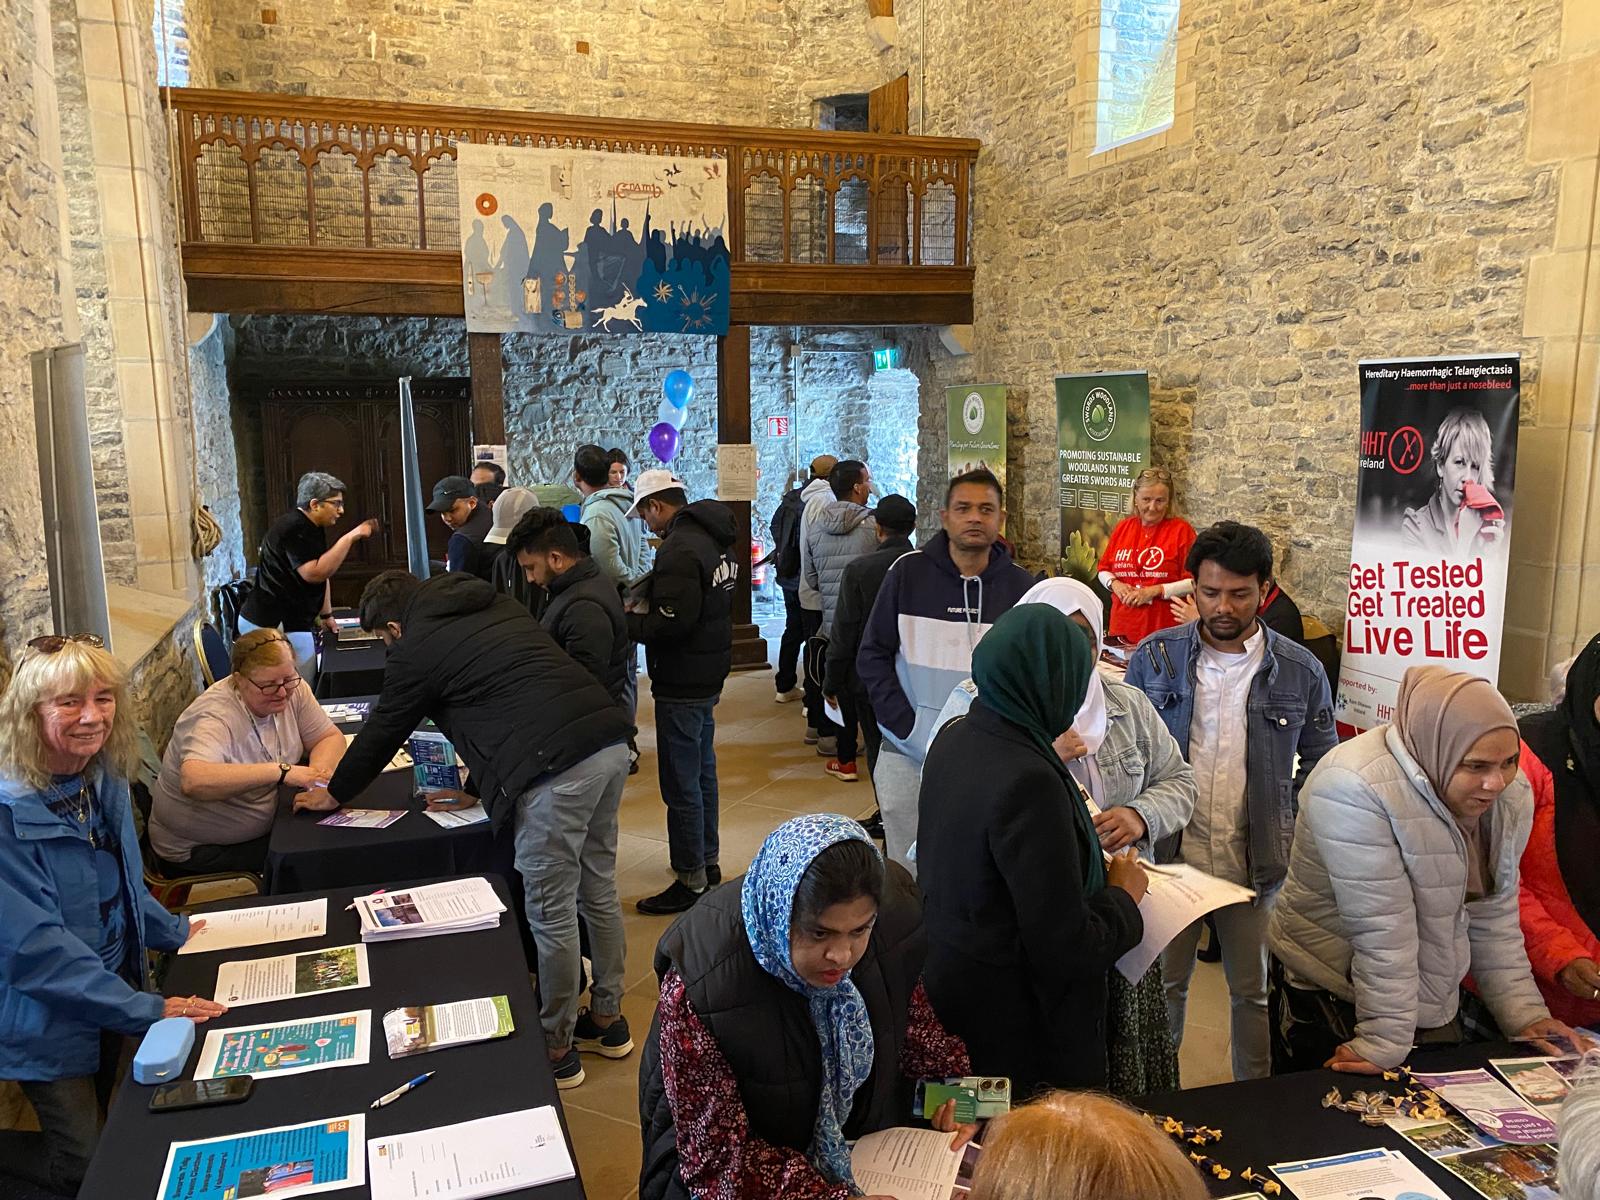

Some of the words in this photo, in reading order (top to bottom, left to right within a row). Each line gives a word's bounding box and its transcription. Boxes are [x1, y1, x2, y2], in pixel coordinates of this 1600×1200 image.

[1365, 368, 1400, 380] Hereditary
[1400, 366, 1453, 379] Haemorrhagic
[1454, 364, 1513, 377] Telangiectasia
[1429, 381, 1446, 390] than
[1447, 381, 1461, 392] just
[1469, 379, 1512, 390] nosebleed
[1084, 393, 1096, 424] SWORDS
[1095, 391, 1115, 424] WOODLAND
[1360, 431, 1388, 456] HHT
[1059, 450, 1096, 461] PROMOTING
[1097, 451, 1141, 463] SUSTAINABLE
[1068, 462, 1108, 474] WOODLANDS
[1109, 464, 1117, 474] IN
[1118, 465, 1129, 475] THE
[1061, 474, 1090, 485] GREATER
[1090, 475, 1118, 487] SWORDS
[1349, 562, 1385, 590] Get
[1392, 557, 1483, 589] Tested
[1348, 591, 1383, 617] Get
[1390, 589, 1485, 618] Treated
[1346, 619, 1413, 656] Live
[1424, 619, 1488, 660] Life
